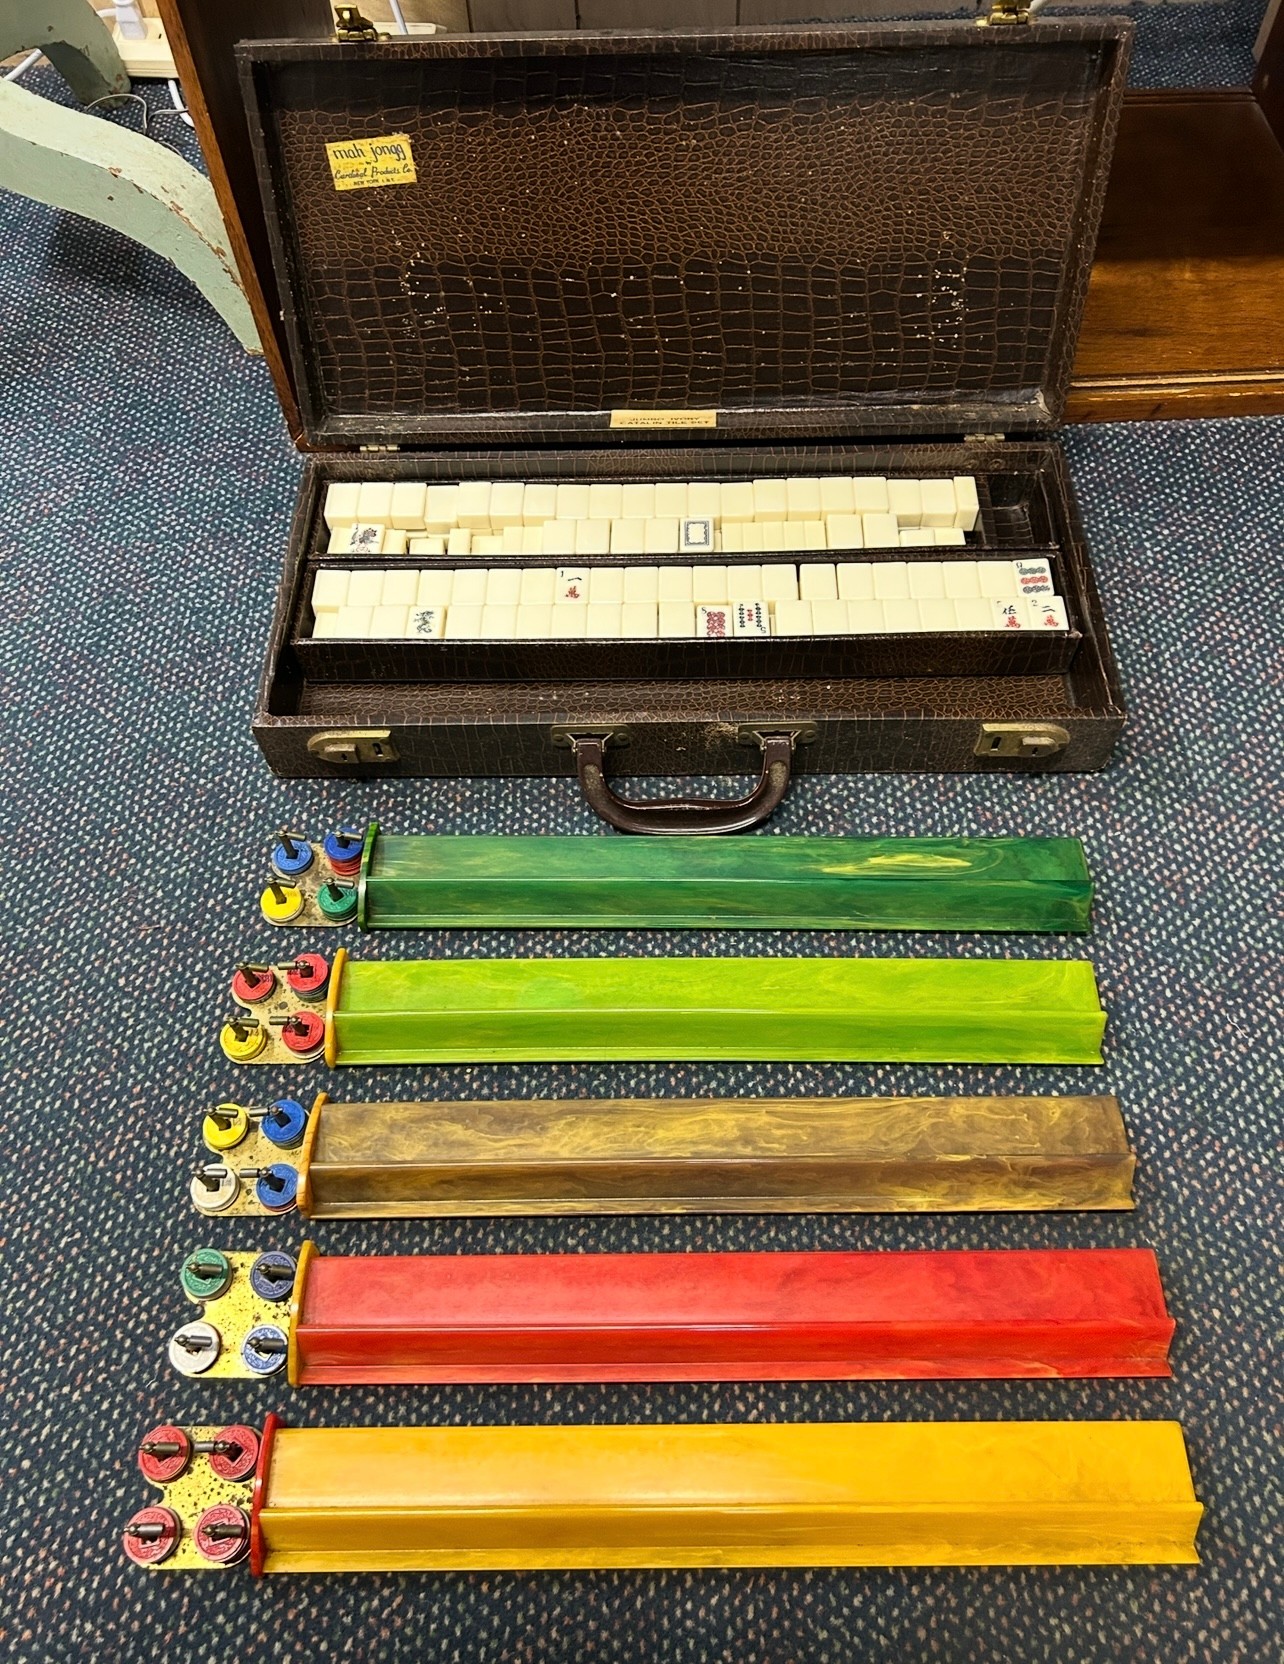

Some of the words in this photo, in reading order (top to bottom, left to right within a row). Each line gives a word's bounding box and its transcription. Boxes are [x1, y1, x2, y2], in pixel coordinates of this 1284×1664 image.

[333, 143, 366, 160] mah
[369, 143, 407, 163] jongg
[371, 165, 401, 178] Products
